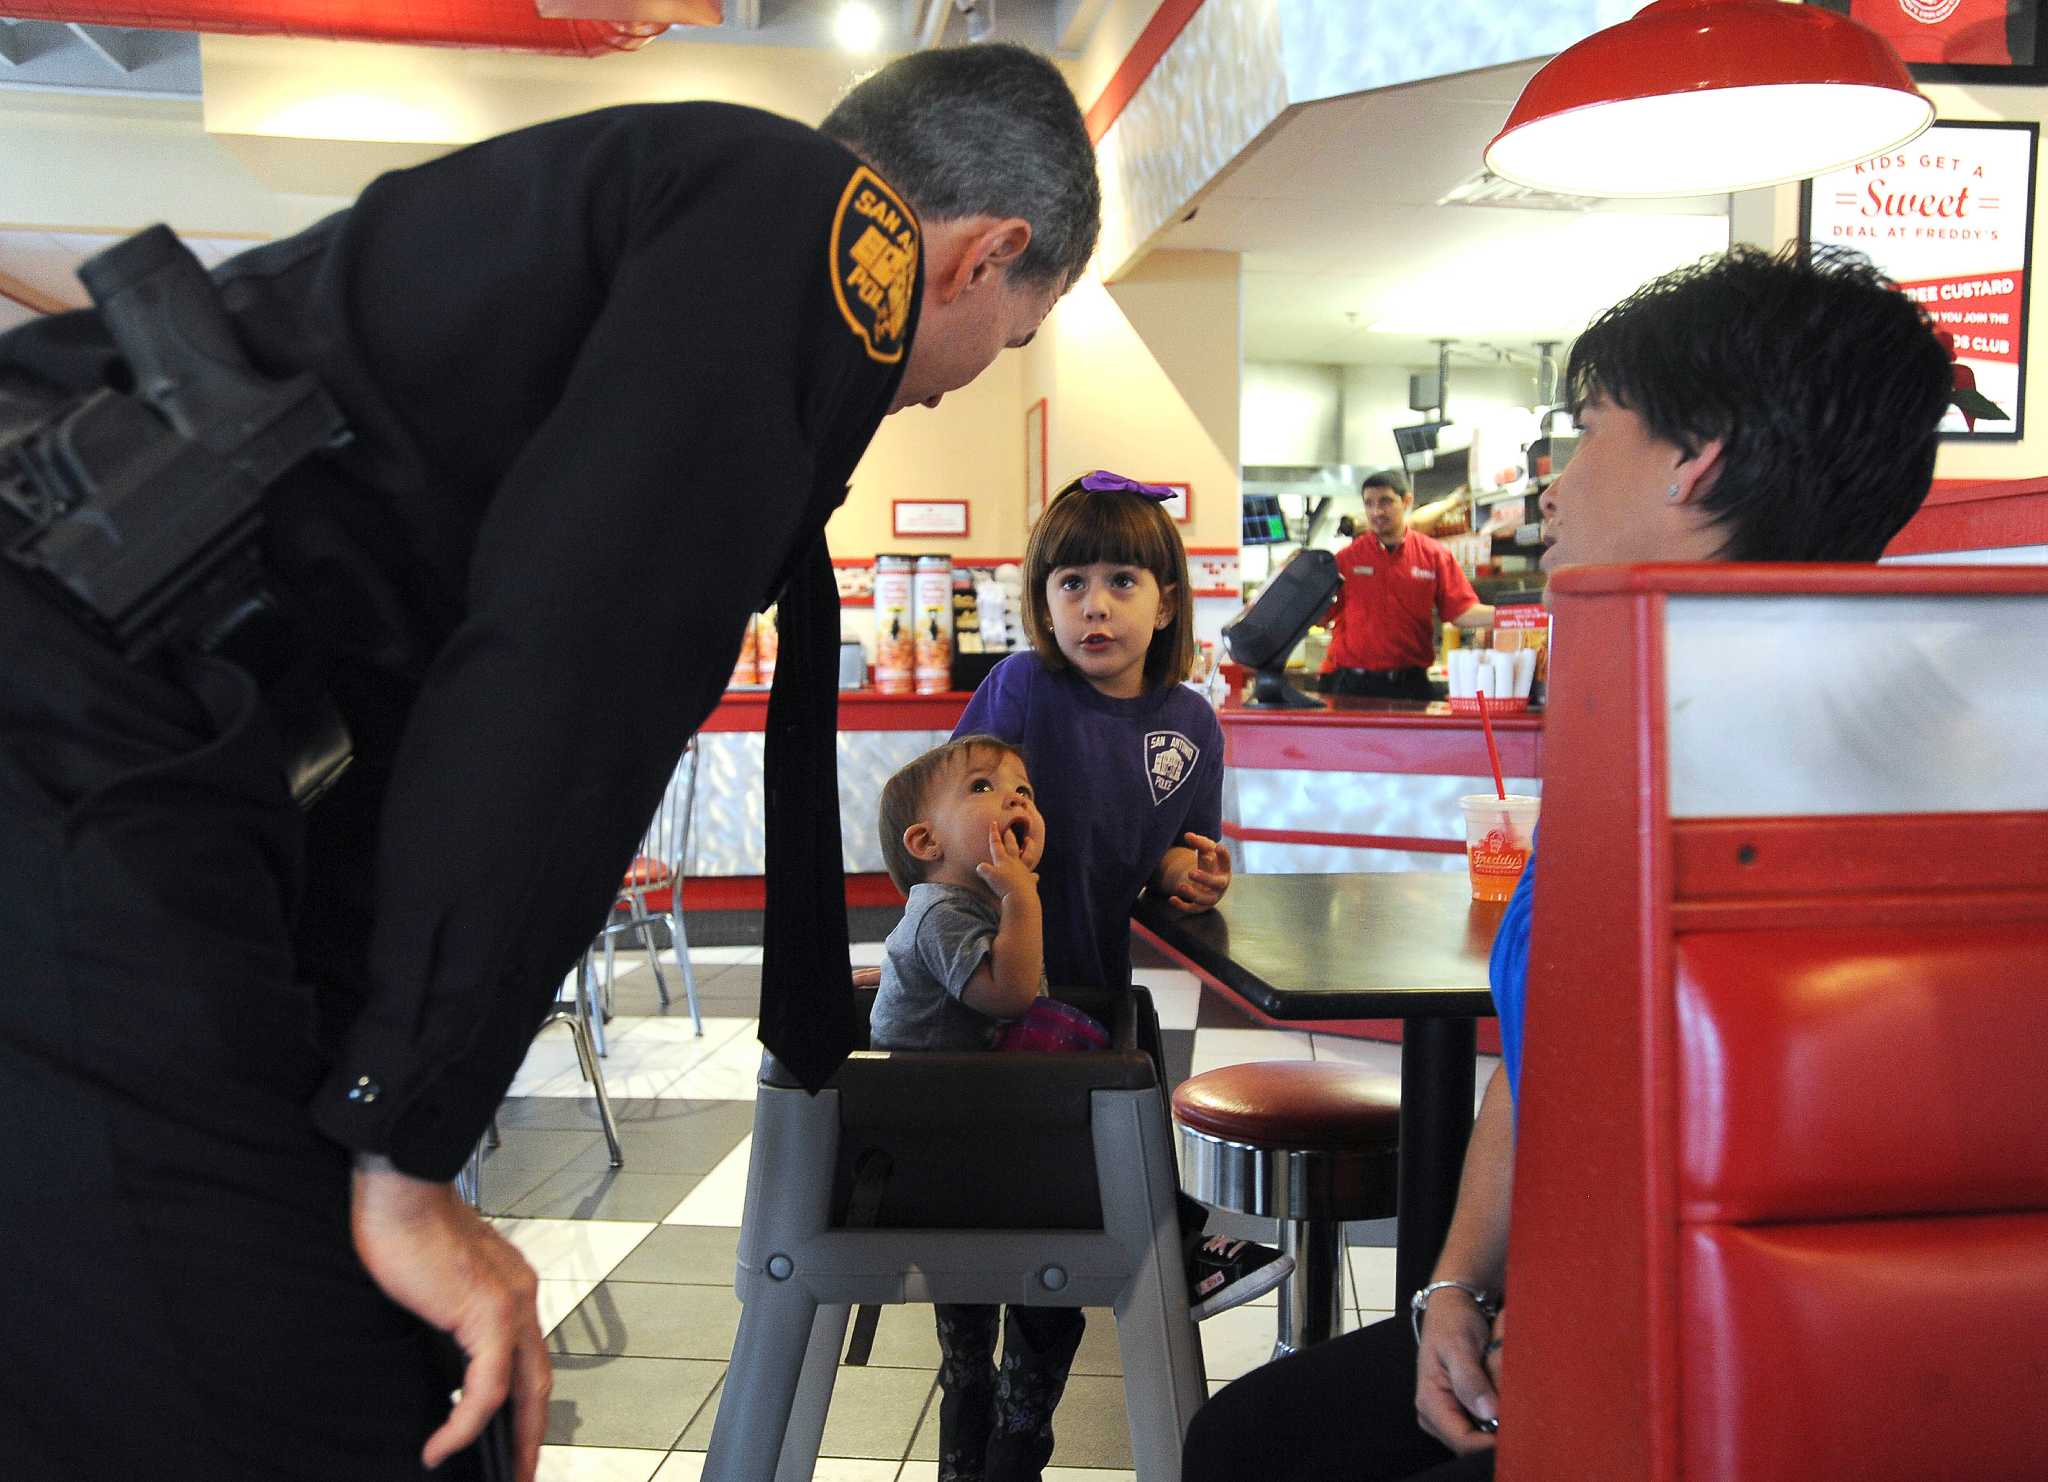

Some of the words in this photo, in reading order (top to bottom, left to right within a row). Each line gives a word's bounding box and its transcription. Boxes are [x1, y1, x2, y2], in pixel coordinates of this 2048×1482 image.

[1854, 154, 1906, 175] KIDS
[1919, 154, 1960, 171] GET
[1972, 165, 1984, 178] A
[1860, 178, 1969, 218] Sweet
[854, 188, 902, 235] SAN
[1833, 225, 1878, 237] DEAL
[1887, 226, 1906, 237] AT
[1915, 227, 1999, 240] FREDDY'S
[1940, 277, 2015, 300] CUSTARD
[1940, 311, 1963, 323] YOU
[1964, 311, 1988, 324] JOIN
[1989, 312, 2010, 325] THE
[1971, 336, 2010, 354] CLUB
[1150, 735, 1166, 749] SAN
[1473, 850, 1523, 869] Freddy's
